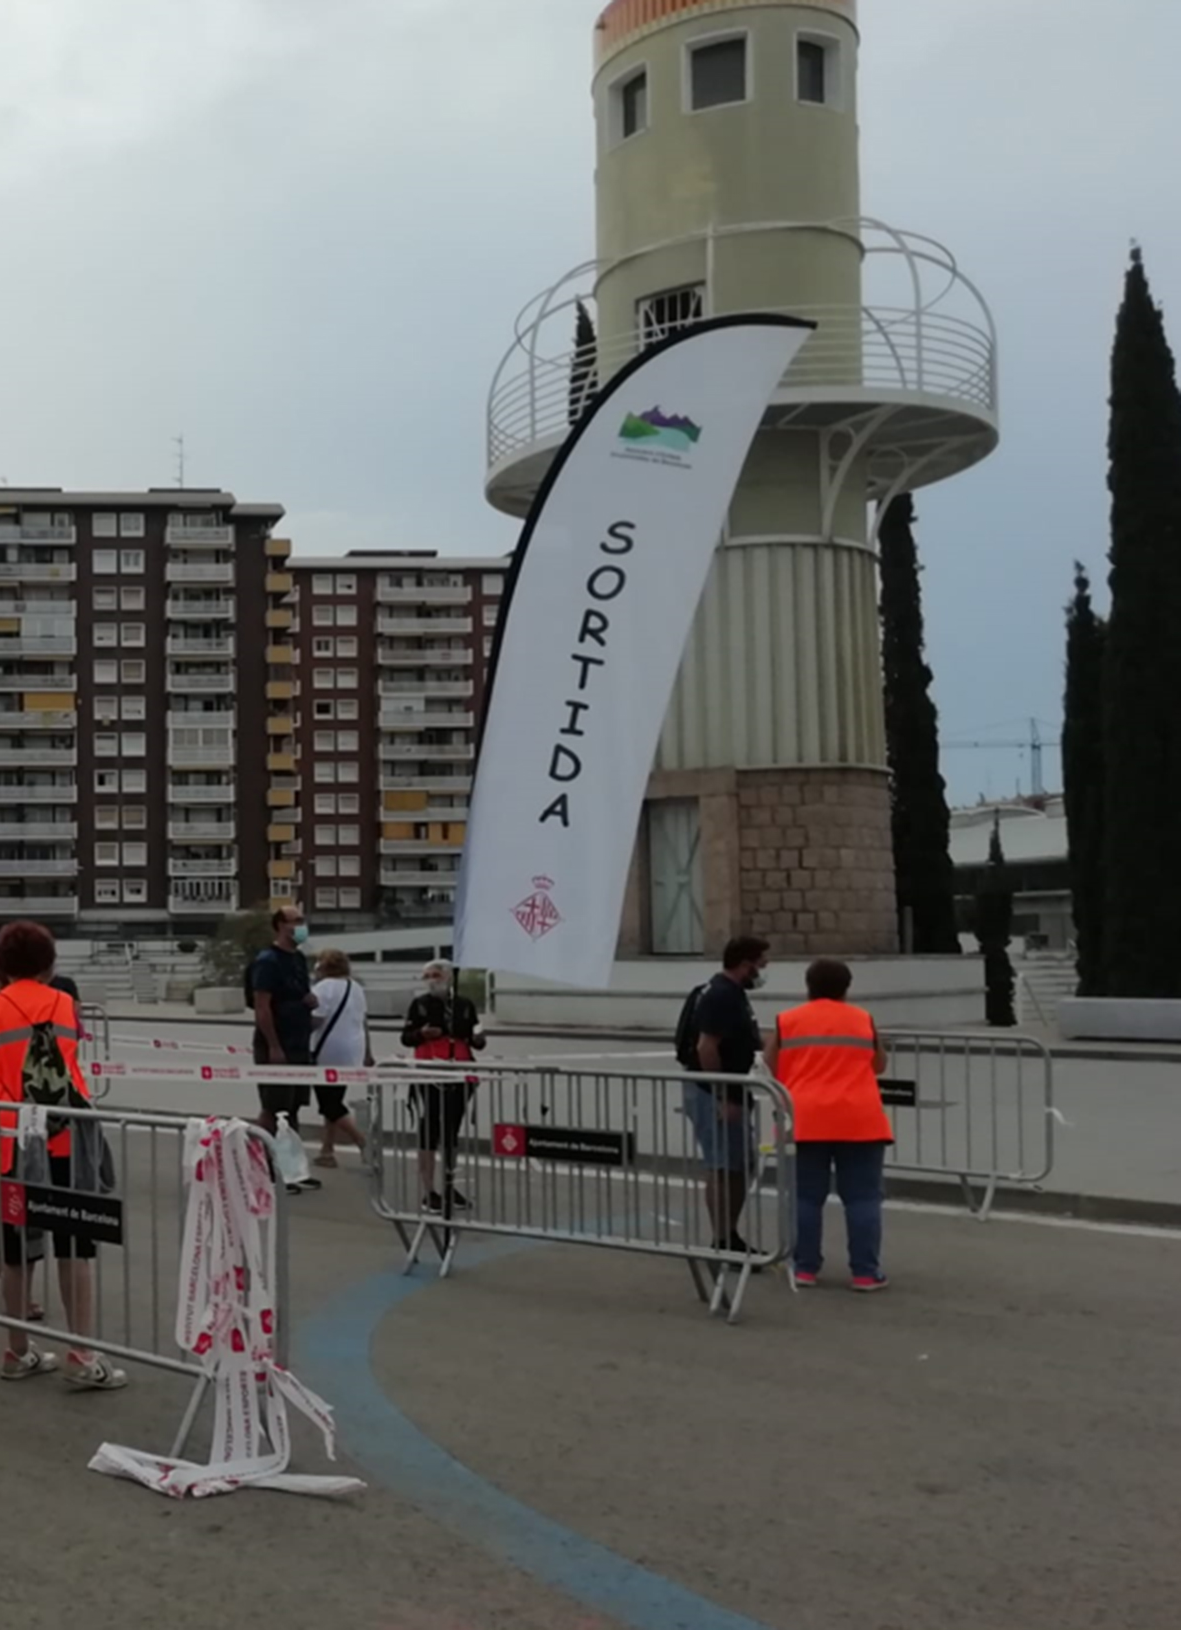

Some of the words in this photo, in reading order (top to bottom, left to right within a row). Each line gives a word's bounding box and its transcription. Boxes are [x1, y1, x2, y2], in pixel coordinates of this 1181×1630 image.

[538, 520, 637, 828] SORTIDA
[27, 1200, 69, 1217] Ajuntament
[70, 1207, 80, 1219] de
[81, 1208, 120, 1227] Barcelona
